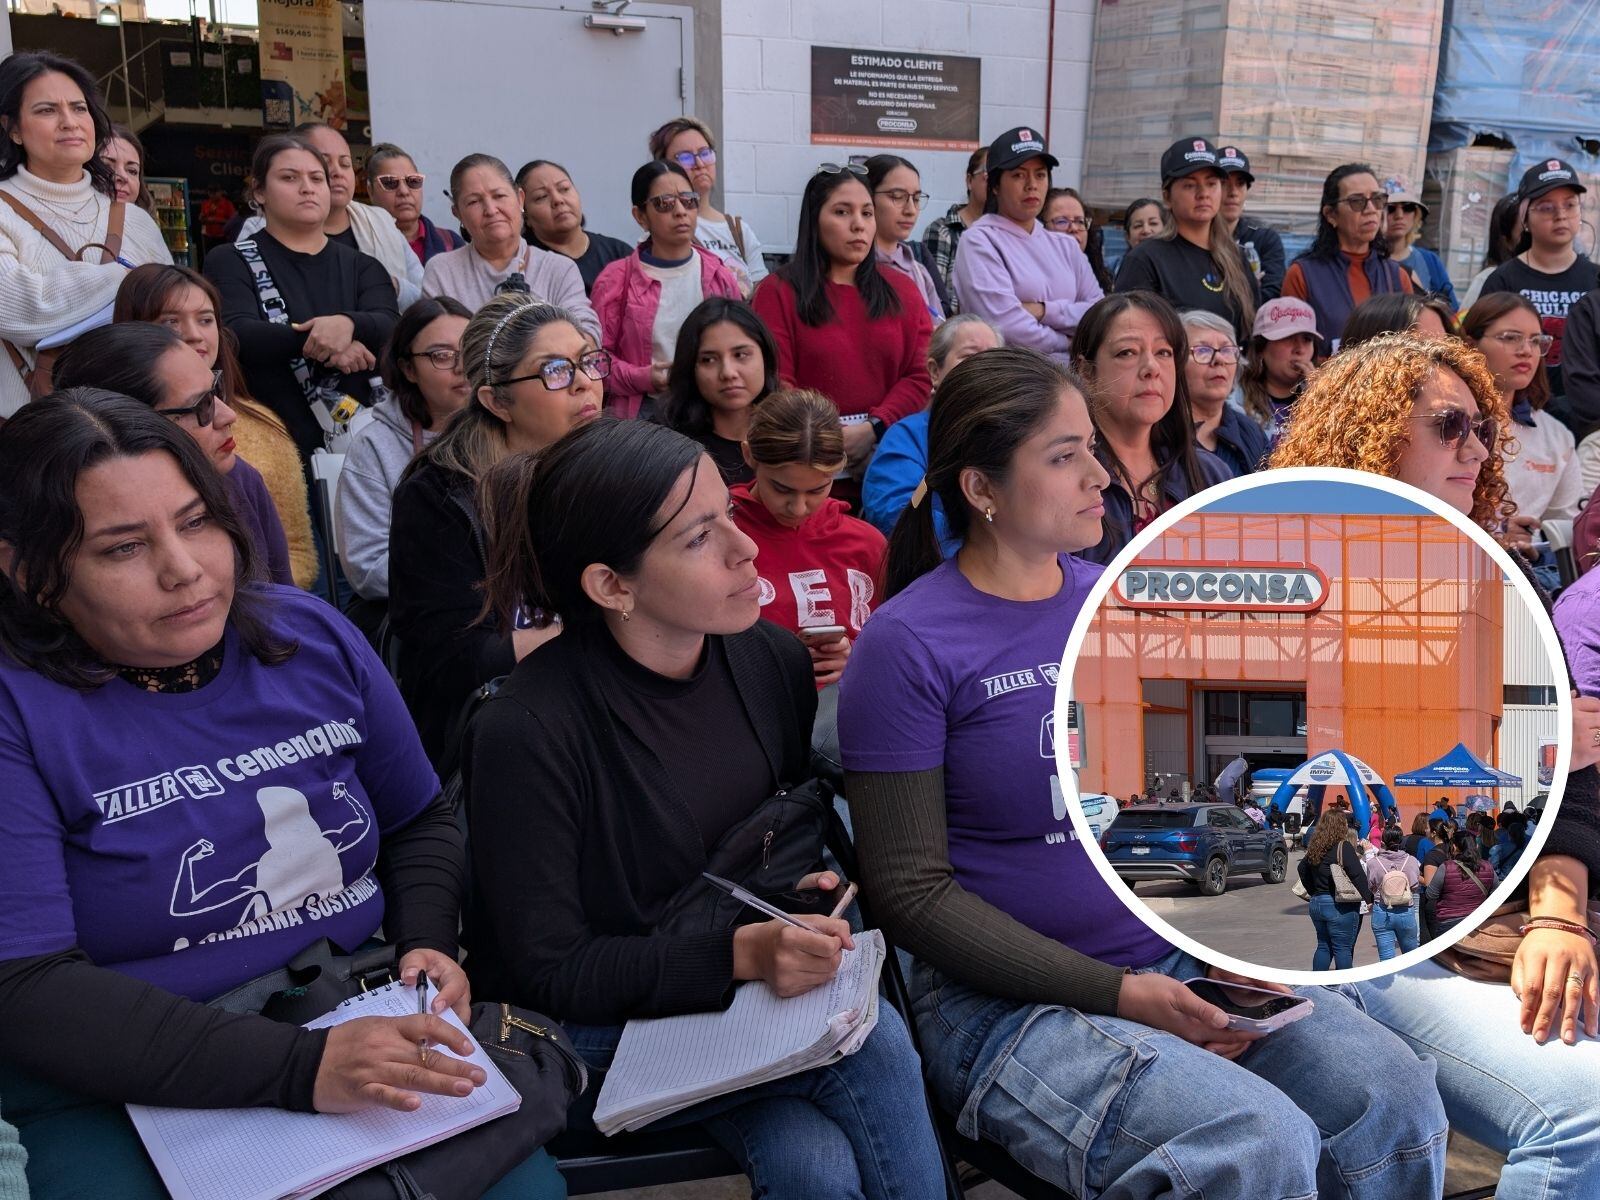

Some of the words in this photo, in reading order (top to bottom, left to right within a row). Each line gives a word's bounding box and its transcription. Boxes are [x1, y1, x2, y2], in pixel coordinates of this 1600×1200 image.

[851, 55, 902, 68] ESTIMADO
[903, 59, 944, 71] CLIENTE
[858, 71, 895, 80] INFORMAMOS
[843, 79, 870, 87] MATERIAL
[880, 81, 897, 89] PARTE
[907, 83, 932, 91] NUESTRO
[857, 99, 895, 108] OBLIGATORIO
[886, 92, 918, 100] NECESARIO
[1520, 289, 1587, 304] CHICAG
[1126, 571, 1314, 604] PROCONSA
[984, 671, 1037, 696] TALLER
[95, 775, 180, 819] TALLER
